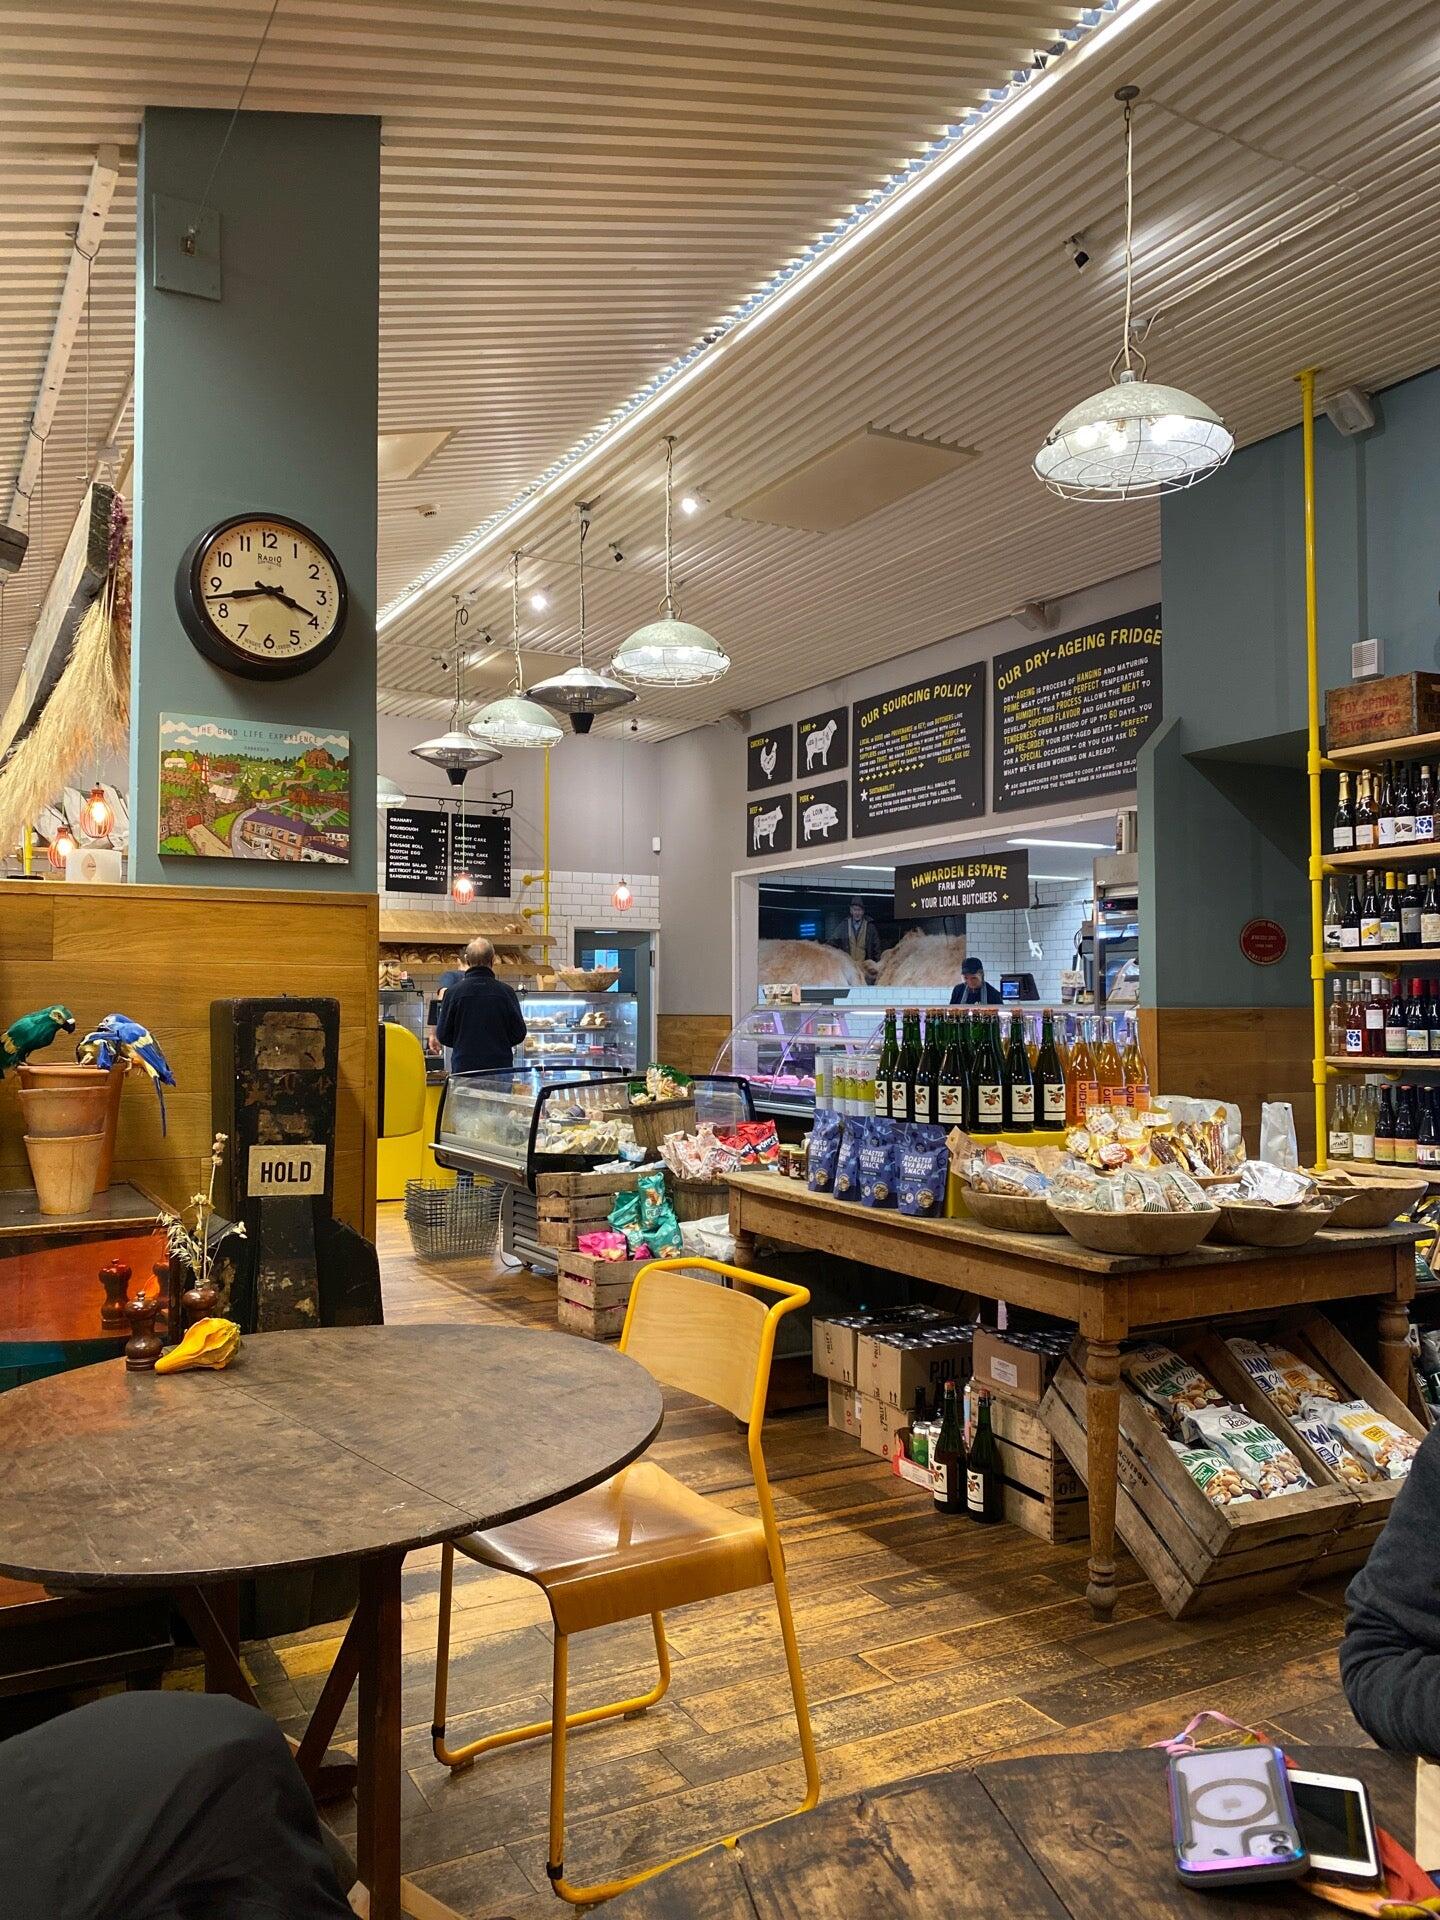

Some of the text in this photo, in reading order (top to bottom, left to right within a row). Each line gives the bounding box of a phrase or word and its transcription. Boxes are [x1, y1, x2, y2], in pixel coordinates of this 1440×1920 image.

[240, 535, 250, 552] 11
[262, 532, 278, 549] 12
[257, 553, 282, 563] RADIO
[294, 543, 298, 558] 1
[218, 551, 232, 568] 10
[308, 564, 320, 580] 2
[210, 577, 222, 592] 9
[316, 590, 327, 606] 3
[218, 603, 229, 619] 8
[308, 615, 319, 630] 4
[237, 624, 248, 639] 7
[289, 630, 300, 646] 5
[263, 634, 275, 649] 6
[998, 628, 1162, 690] OUR DRY-AGEING FRIDGE
[1004, 687, 1035, 703] DRY-AGEING
[1042, 680, 1067, 692] PROCESS
[1077, 668, 1102, 682] HANGING
[1103, 666, 1116, 675] AND
[1117, 656, 1149, 671] MATURING
[1004, 702, 1020, 714] PRIME
[1021, 700, 1036, 709] MEAT
[1036, 696, 1051, 704] CUTS
[1061, 689, 1072, 698] THE
[1074, 680, 1099, 694] PERFECT
[1101, 669, 1144, 687] TEMPERATURE
[861, 683, 972, 728] OUR SOURCING POLICY
[1004, 716, 1014, 724] AND
[1043, 705, 1055, 713] THIS
[1056, 696, 1082, 710] PROCESS
[1083, 691, 1107, 703] ALLOWS
[1108, 688, 1120, 696] THE
[1121, 680, 1140, 693] MEAT
[1004, 696, 1135, 734] DEVELOP SUPERIOR FLAVOUR AND GUARANTEED
[1004, 730, 1037, 745] TENDERNESS
[1038, 728, 1052, 736] OVER
[1059, 721, 1079, 731] PERIOD
[1108, 709, 1118, 719] 60
[1119, 707, 1137, 717] DAYS.
[1139, 703, 1152, 711] YOU
[218, 728, 238, 736] GOOD
[269, 732, 318, 743] EXPERIENCE
[1015, 738, 1044, 752] PRE-ORDER
[1046, 736, 1061, 745] YOUR
[1062, 730, 1091, 742] DRY-AGED
[1092, 724, 1112, 734] MEATS
[1120, 715, 1148, 728] PERFECT
[1020, 750, 1042, 762] SPECIAL
[1044, 745, 1070, 757] OCCASION
[1088, 738, 1100, 746] YOU
[1101, 735, 1114, 744] CAN
[1115, 732, 1127, 740] ASK
[1128, 728, 1137, 737] US
[1004, 768, 1018, 776] WHAT
[1020, 763, 1036, 772] WE'VE
[1037, 761, 1051, 769] BEEN
[1052, 755, 1077, 766] WORKING
[1088, 746, 1117, 758] ALREADY.
[911, 864, 1008, 889] HAWARDEN ESTATE
[938, 879, 976, 891] FARM SHOP
[921, 891, 998, 909] YOUR LOCAL BUTCHERS
[261, 1162, 311, 1182] HOLD
